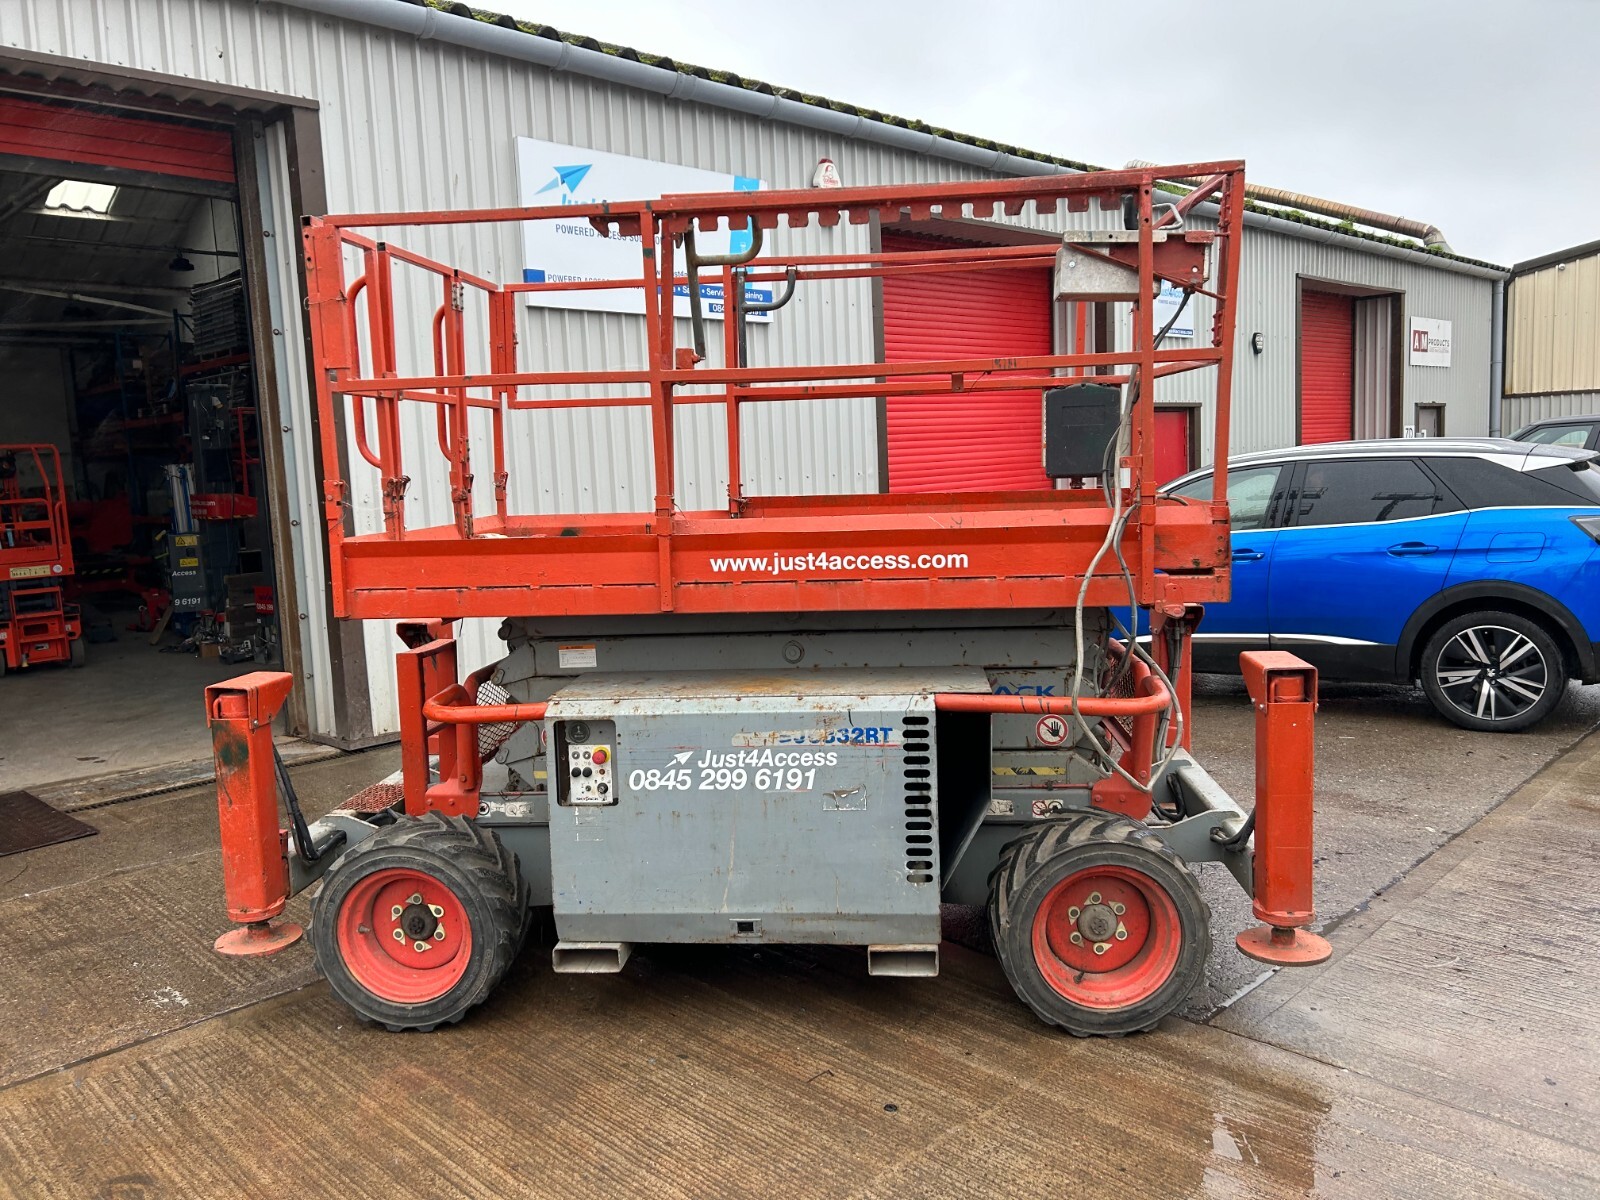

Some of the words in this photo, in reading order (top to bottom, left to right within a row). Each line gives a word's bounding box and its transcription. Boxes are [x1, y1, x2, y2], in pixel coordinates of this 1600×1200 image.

[555, 223, 595, 237] POWERED
[597, 229, 628, 241] ACESS
[706, 287, 724, 297] Servic
[745, 292, 763, 302] aining
[1428, 338, 1450, 347] PRODUCTS
[709, 552, 969, 575] www.just4access.com
[181, 597, 201, 606] 6191
[994, 685, 1056, 697] ACK
[697, 748, 838, 768] Just4Access
[628, 768, 692, 791] 0845
[698, 768, 748, 790] 299
[754, 767, 816, 791] 6191
